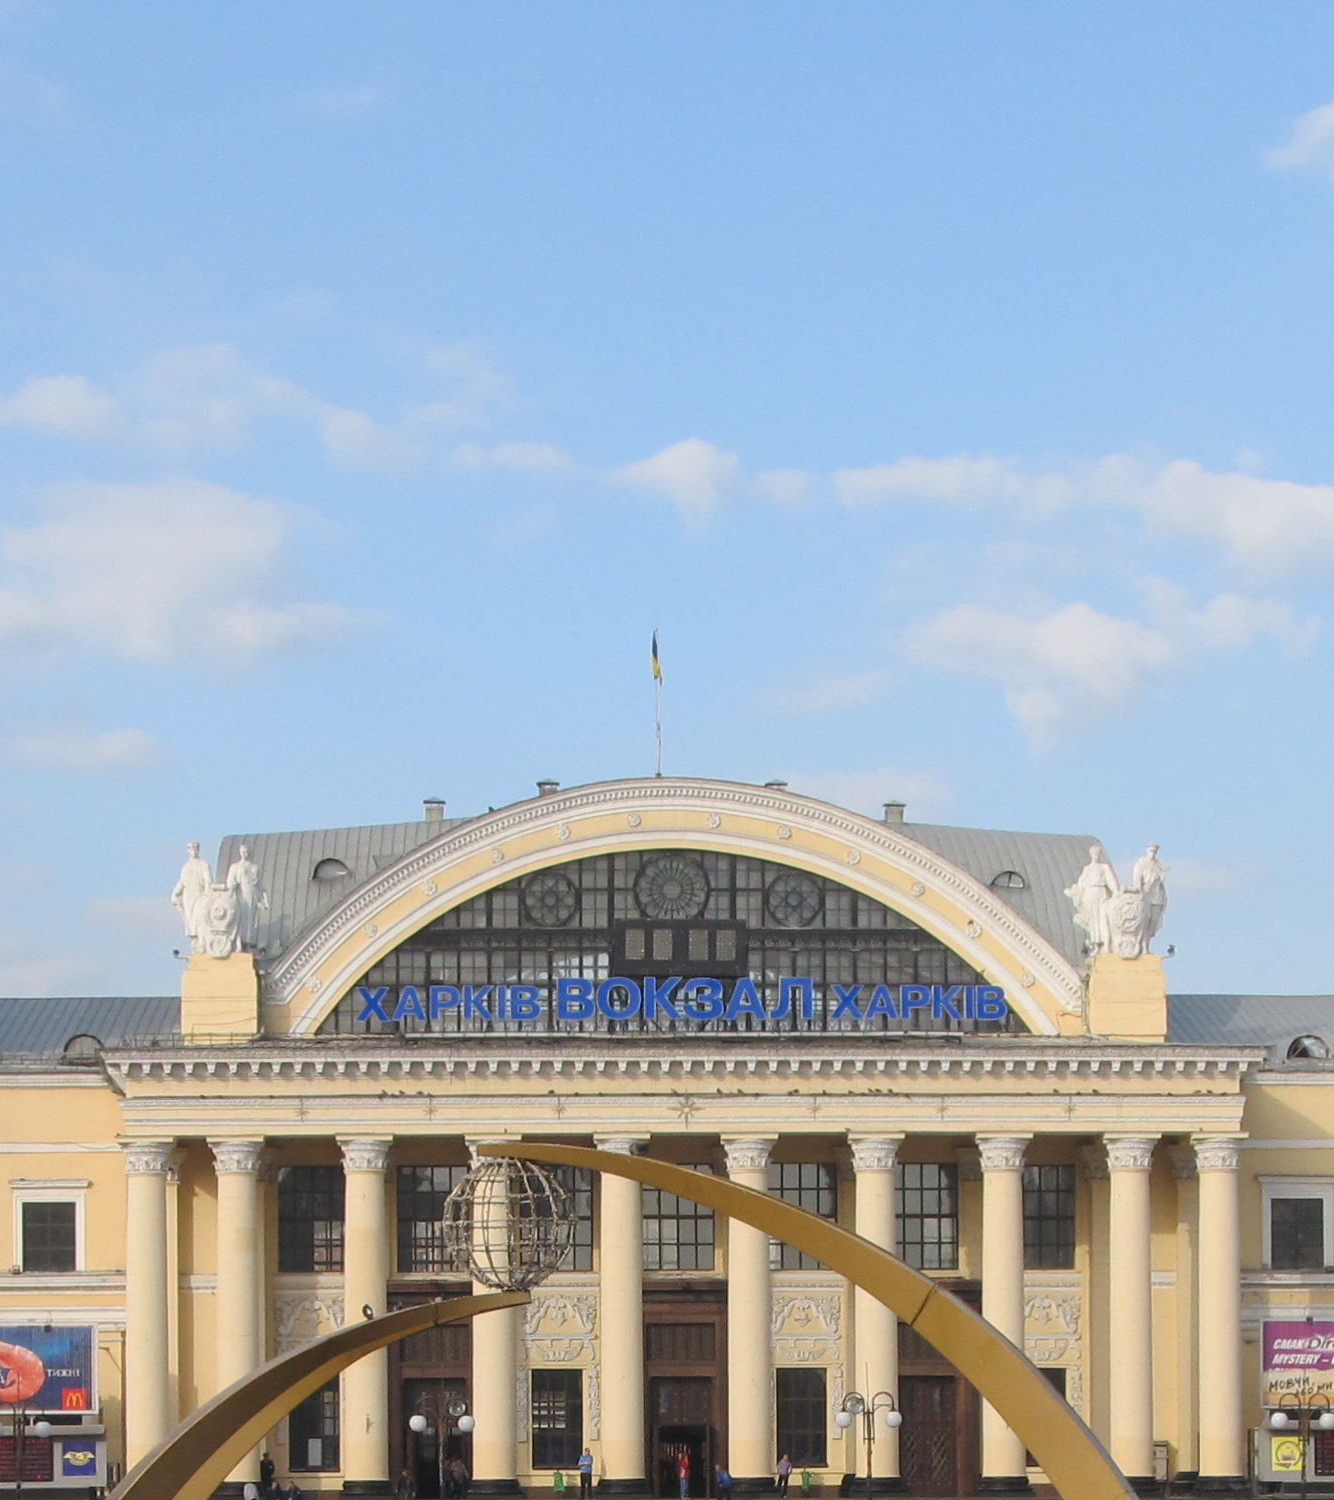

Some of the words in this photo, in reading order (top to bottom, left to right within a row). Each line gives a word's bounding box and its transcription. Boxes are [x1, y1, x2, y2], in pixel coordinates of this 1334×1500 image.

[356, 985, 541, 1021] ХАРКІВ
[557, 977, 814, 1020] ВОКЗАЛ
[830, 984, 1008, 1020] ХАРКІВ
[1273, 1339, 1305, 1350] СМАК
[1271, 1354, 1321, 1365] MYSTERY
